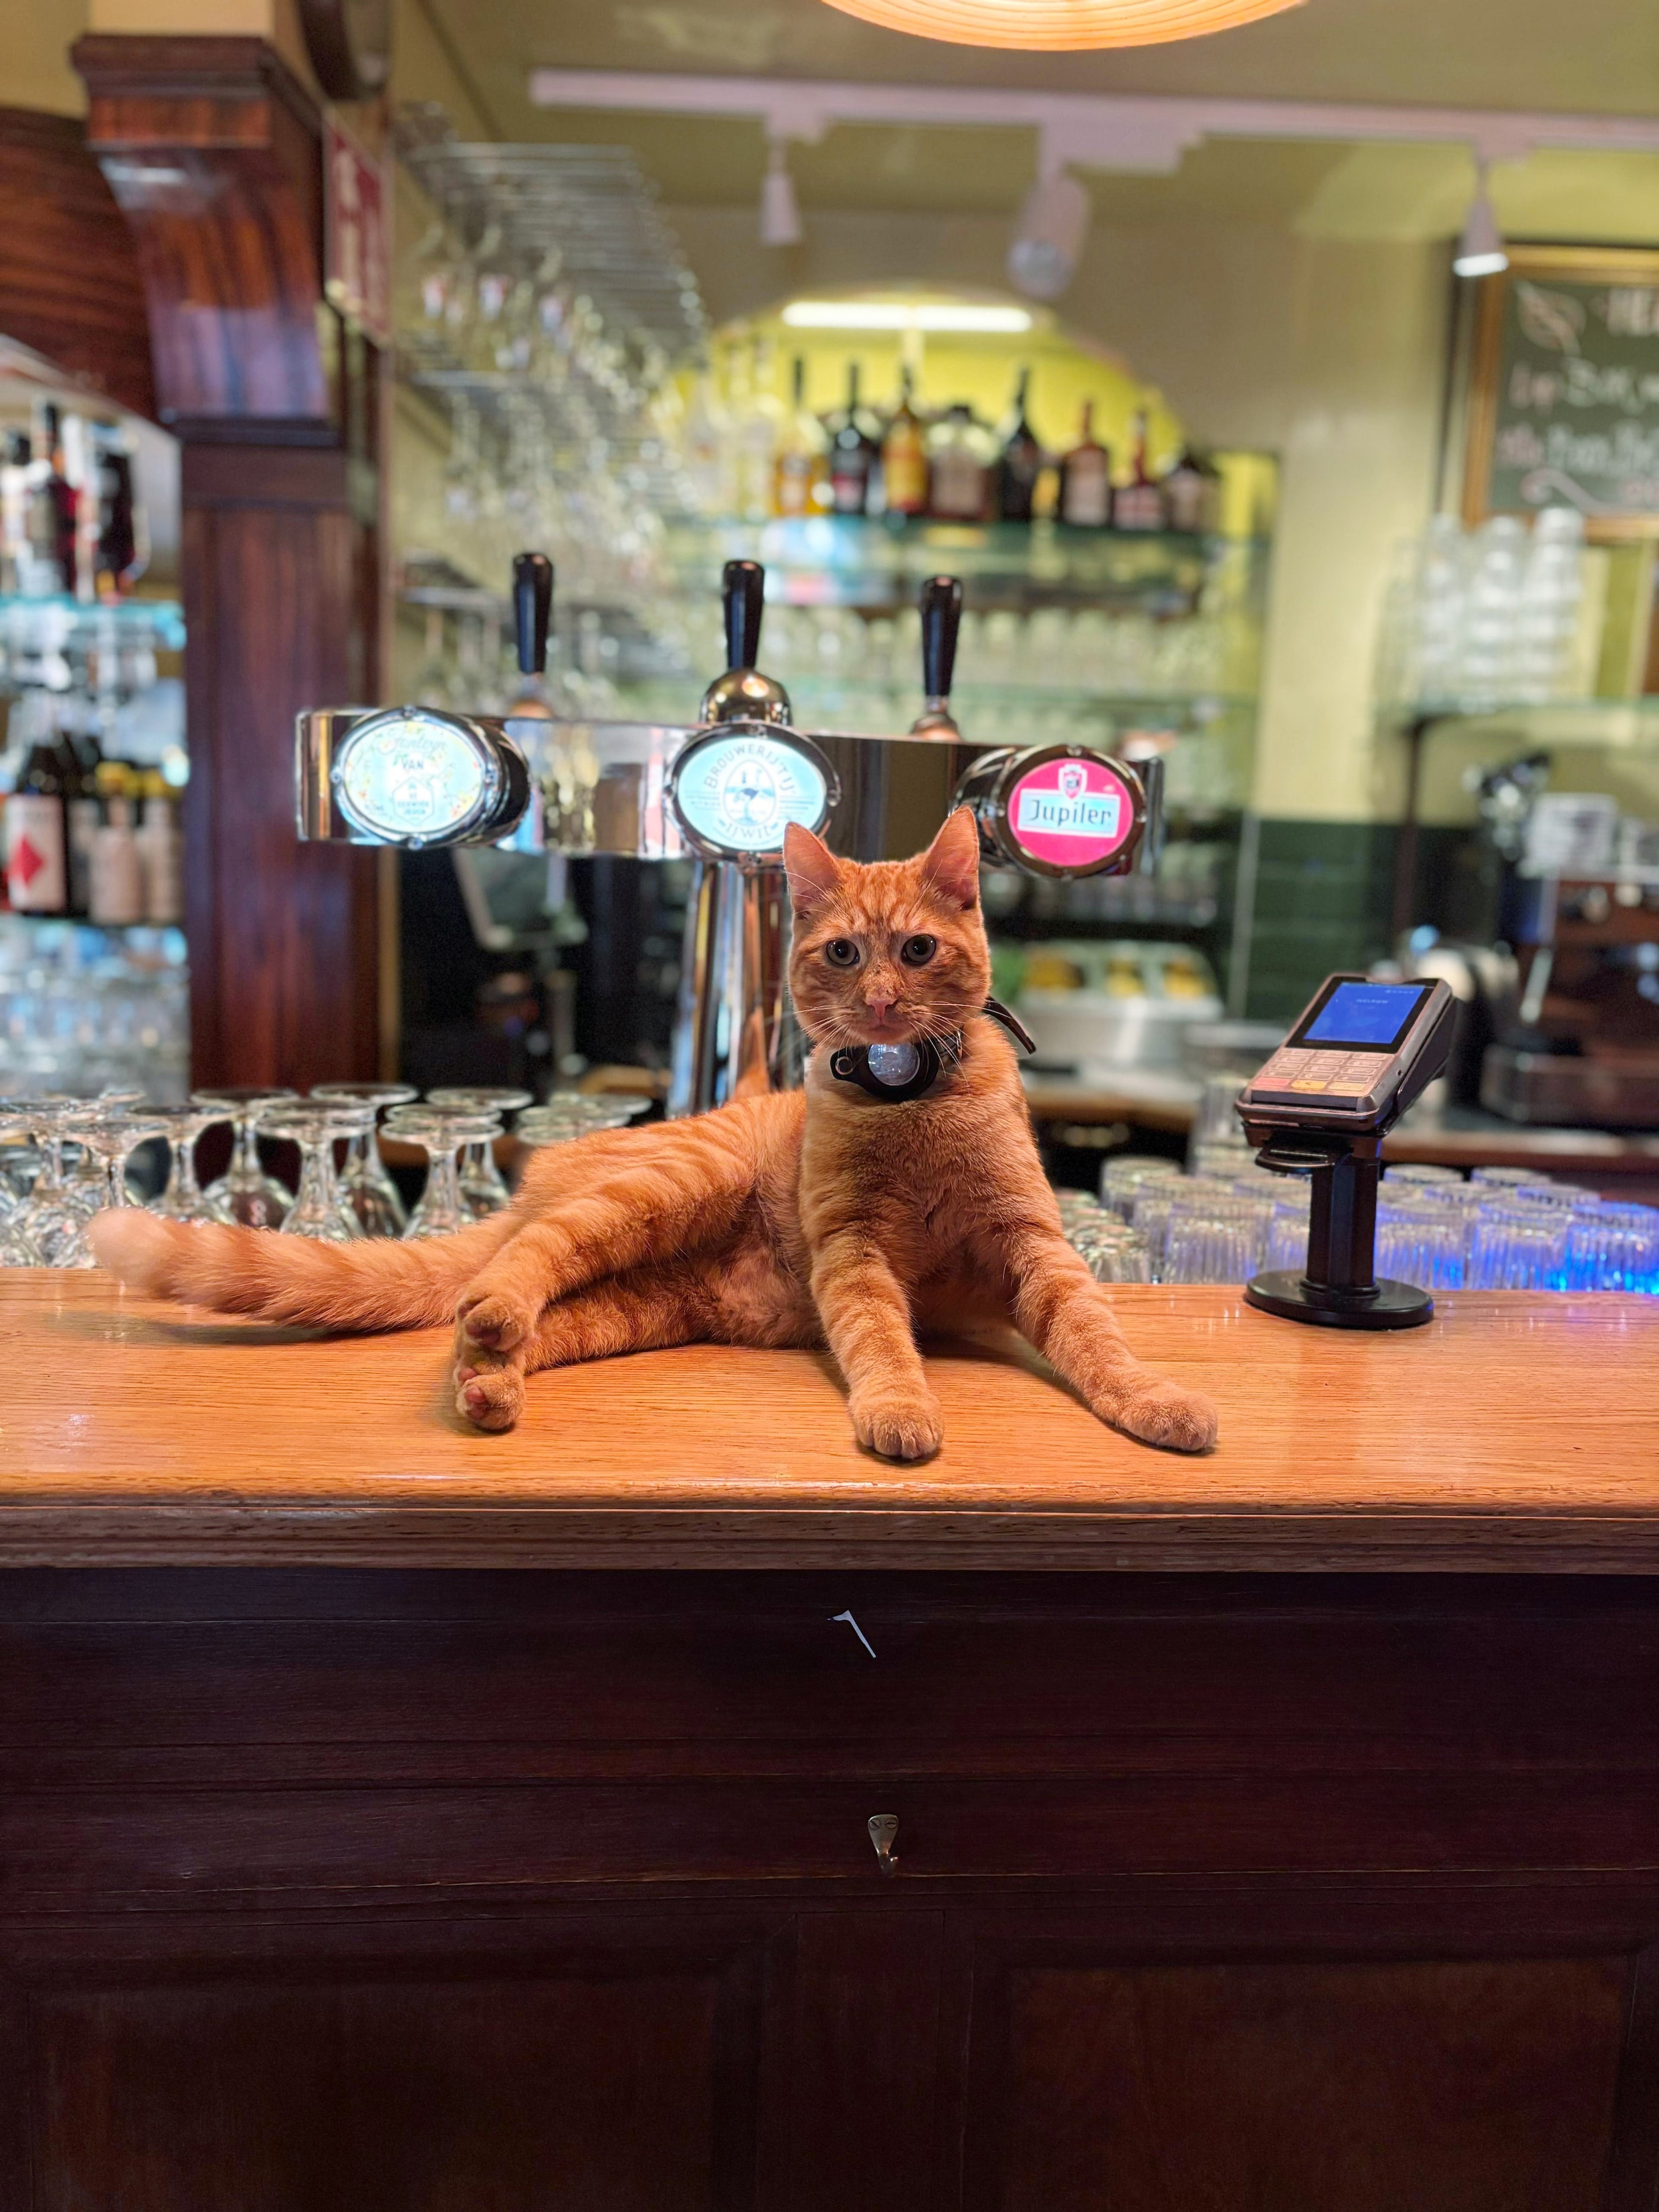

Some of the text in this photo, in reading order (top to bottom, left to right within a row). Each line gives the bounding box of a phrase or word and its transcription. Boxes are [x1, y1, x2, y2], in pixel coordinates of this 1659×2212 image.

[401, 759, 425, 770] VAN
[704, 743, 779, 789] BROUWERIJ
[1030, 799, 1112, 827] Jupiler
[725, 823, 771, 839] IJWIT
